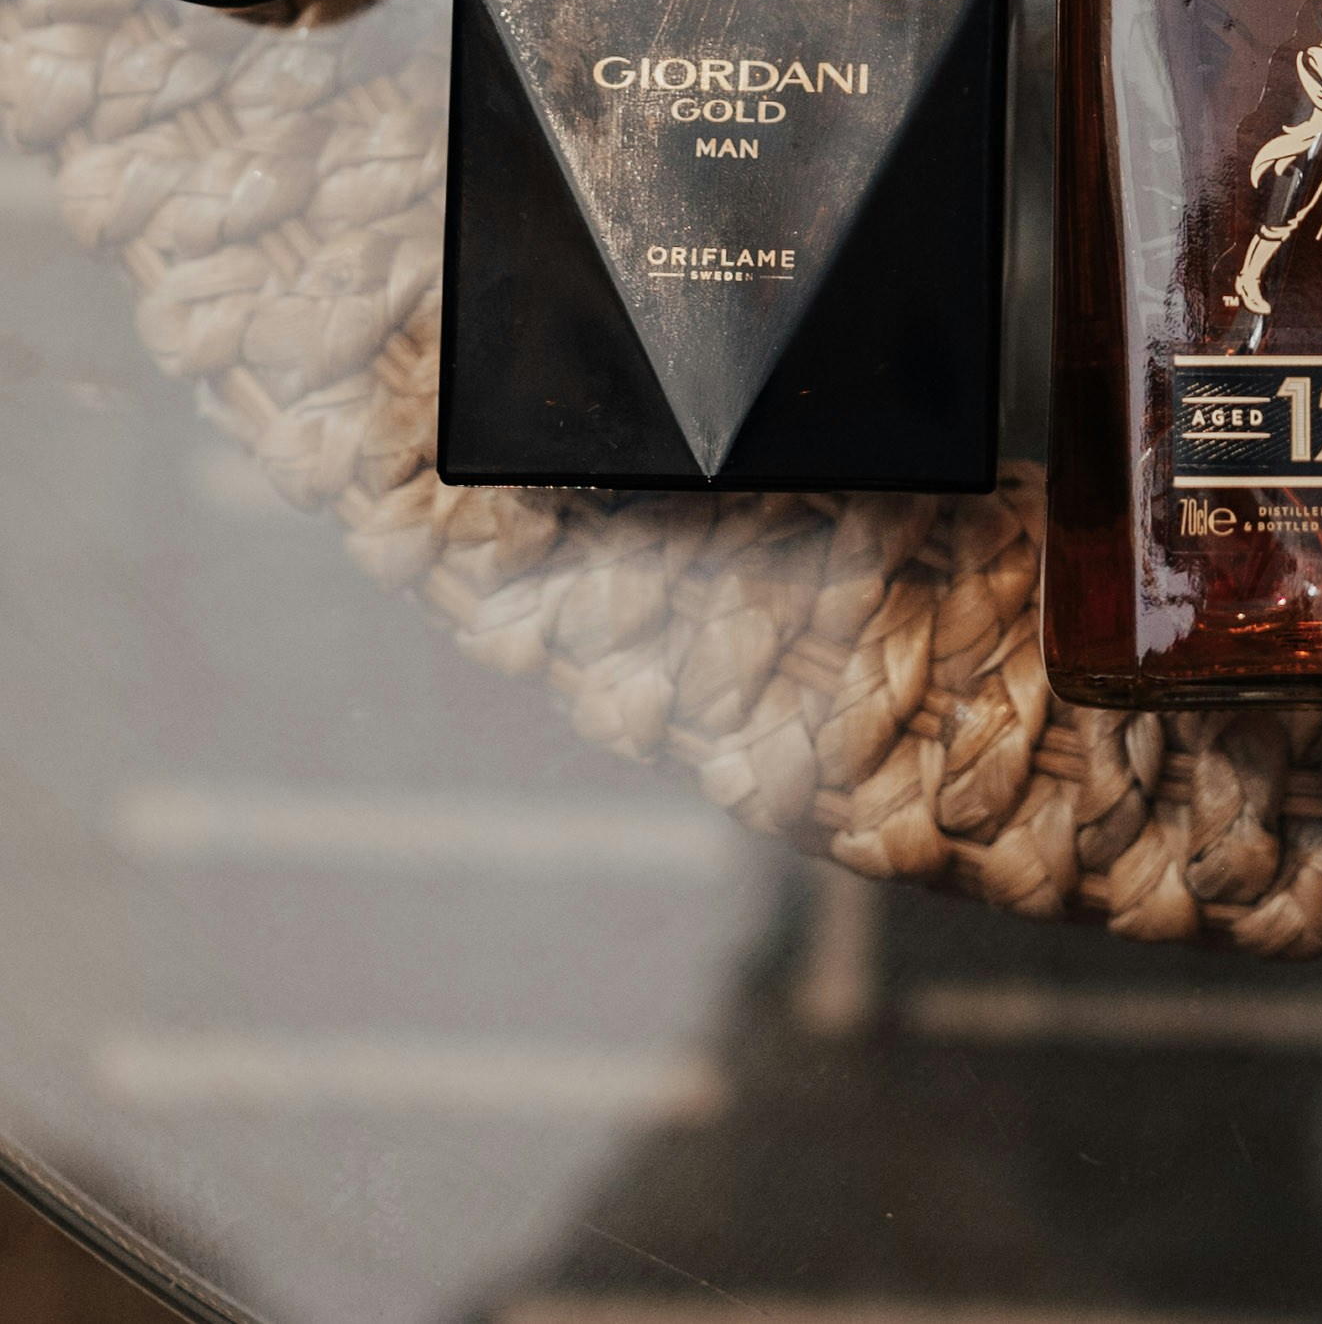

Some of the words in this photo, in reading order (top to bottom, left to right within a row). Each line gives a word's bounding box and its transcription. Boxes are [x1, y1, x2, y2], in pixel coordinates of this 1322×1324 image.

[592, 55, 869, 95] GIORDANI
[670, 97, 787, 124] GOLD
[695, 137, 760, 160] MAN
[646, 245, 796, 268] ORIFLAME
[689, 270, 754, 282] SWEDEN
[1190, 409, 1264, 427] AGED
[1244, 522, 1252, 532] &
[1257, 521, 1319, 532] BOTTLED
